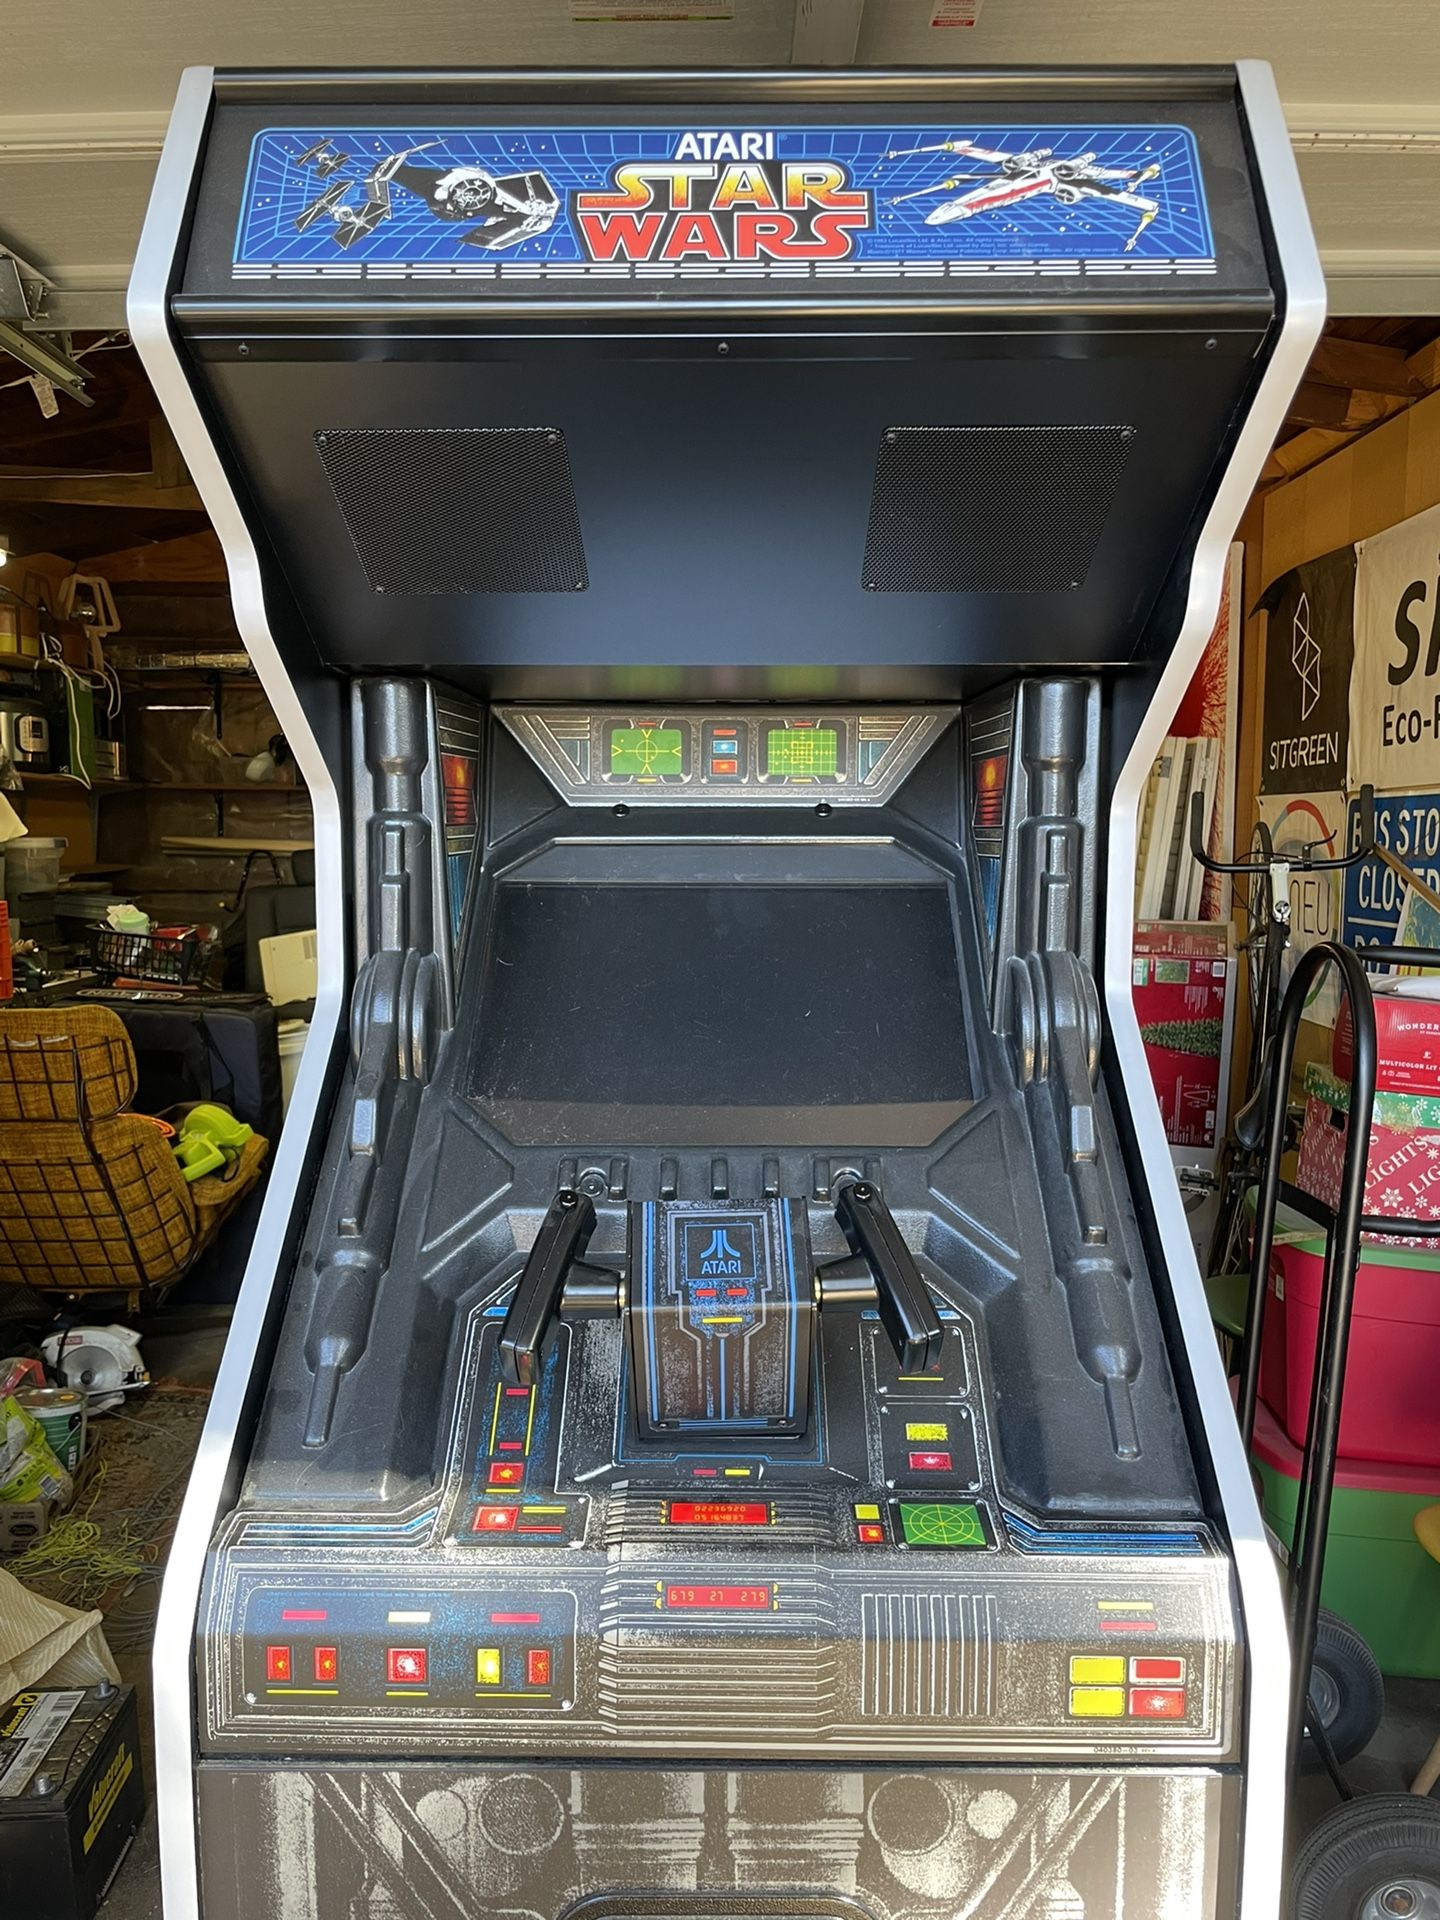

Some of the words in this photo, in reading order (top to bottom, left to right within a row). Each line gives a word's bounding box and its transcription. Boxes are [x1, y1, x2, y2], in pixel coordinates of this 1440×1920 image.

[675, 132, 773, 160] ATARI
[577, 163, 868, 211] STAR
[577, 211, 868, 261] WARS
[1269, 731, 1339, 771] SITGREEN
[1359, 864, 1440, 912] CLOSD
[1379, 1059, 1425, 1070] MULTICOLOR
[1364, 1134, 1430, 1190] LIGHTS
[701, 1260, 741, 1274] ATARI
